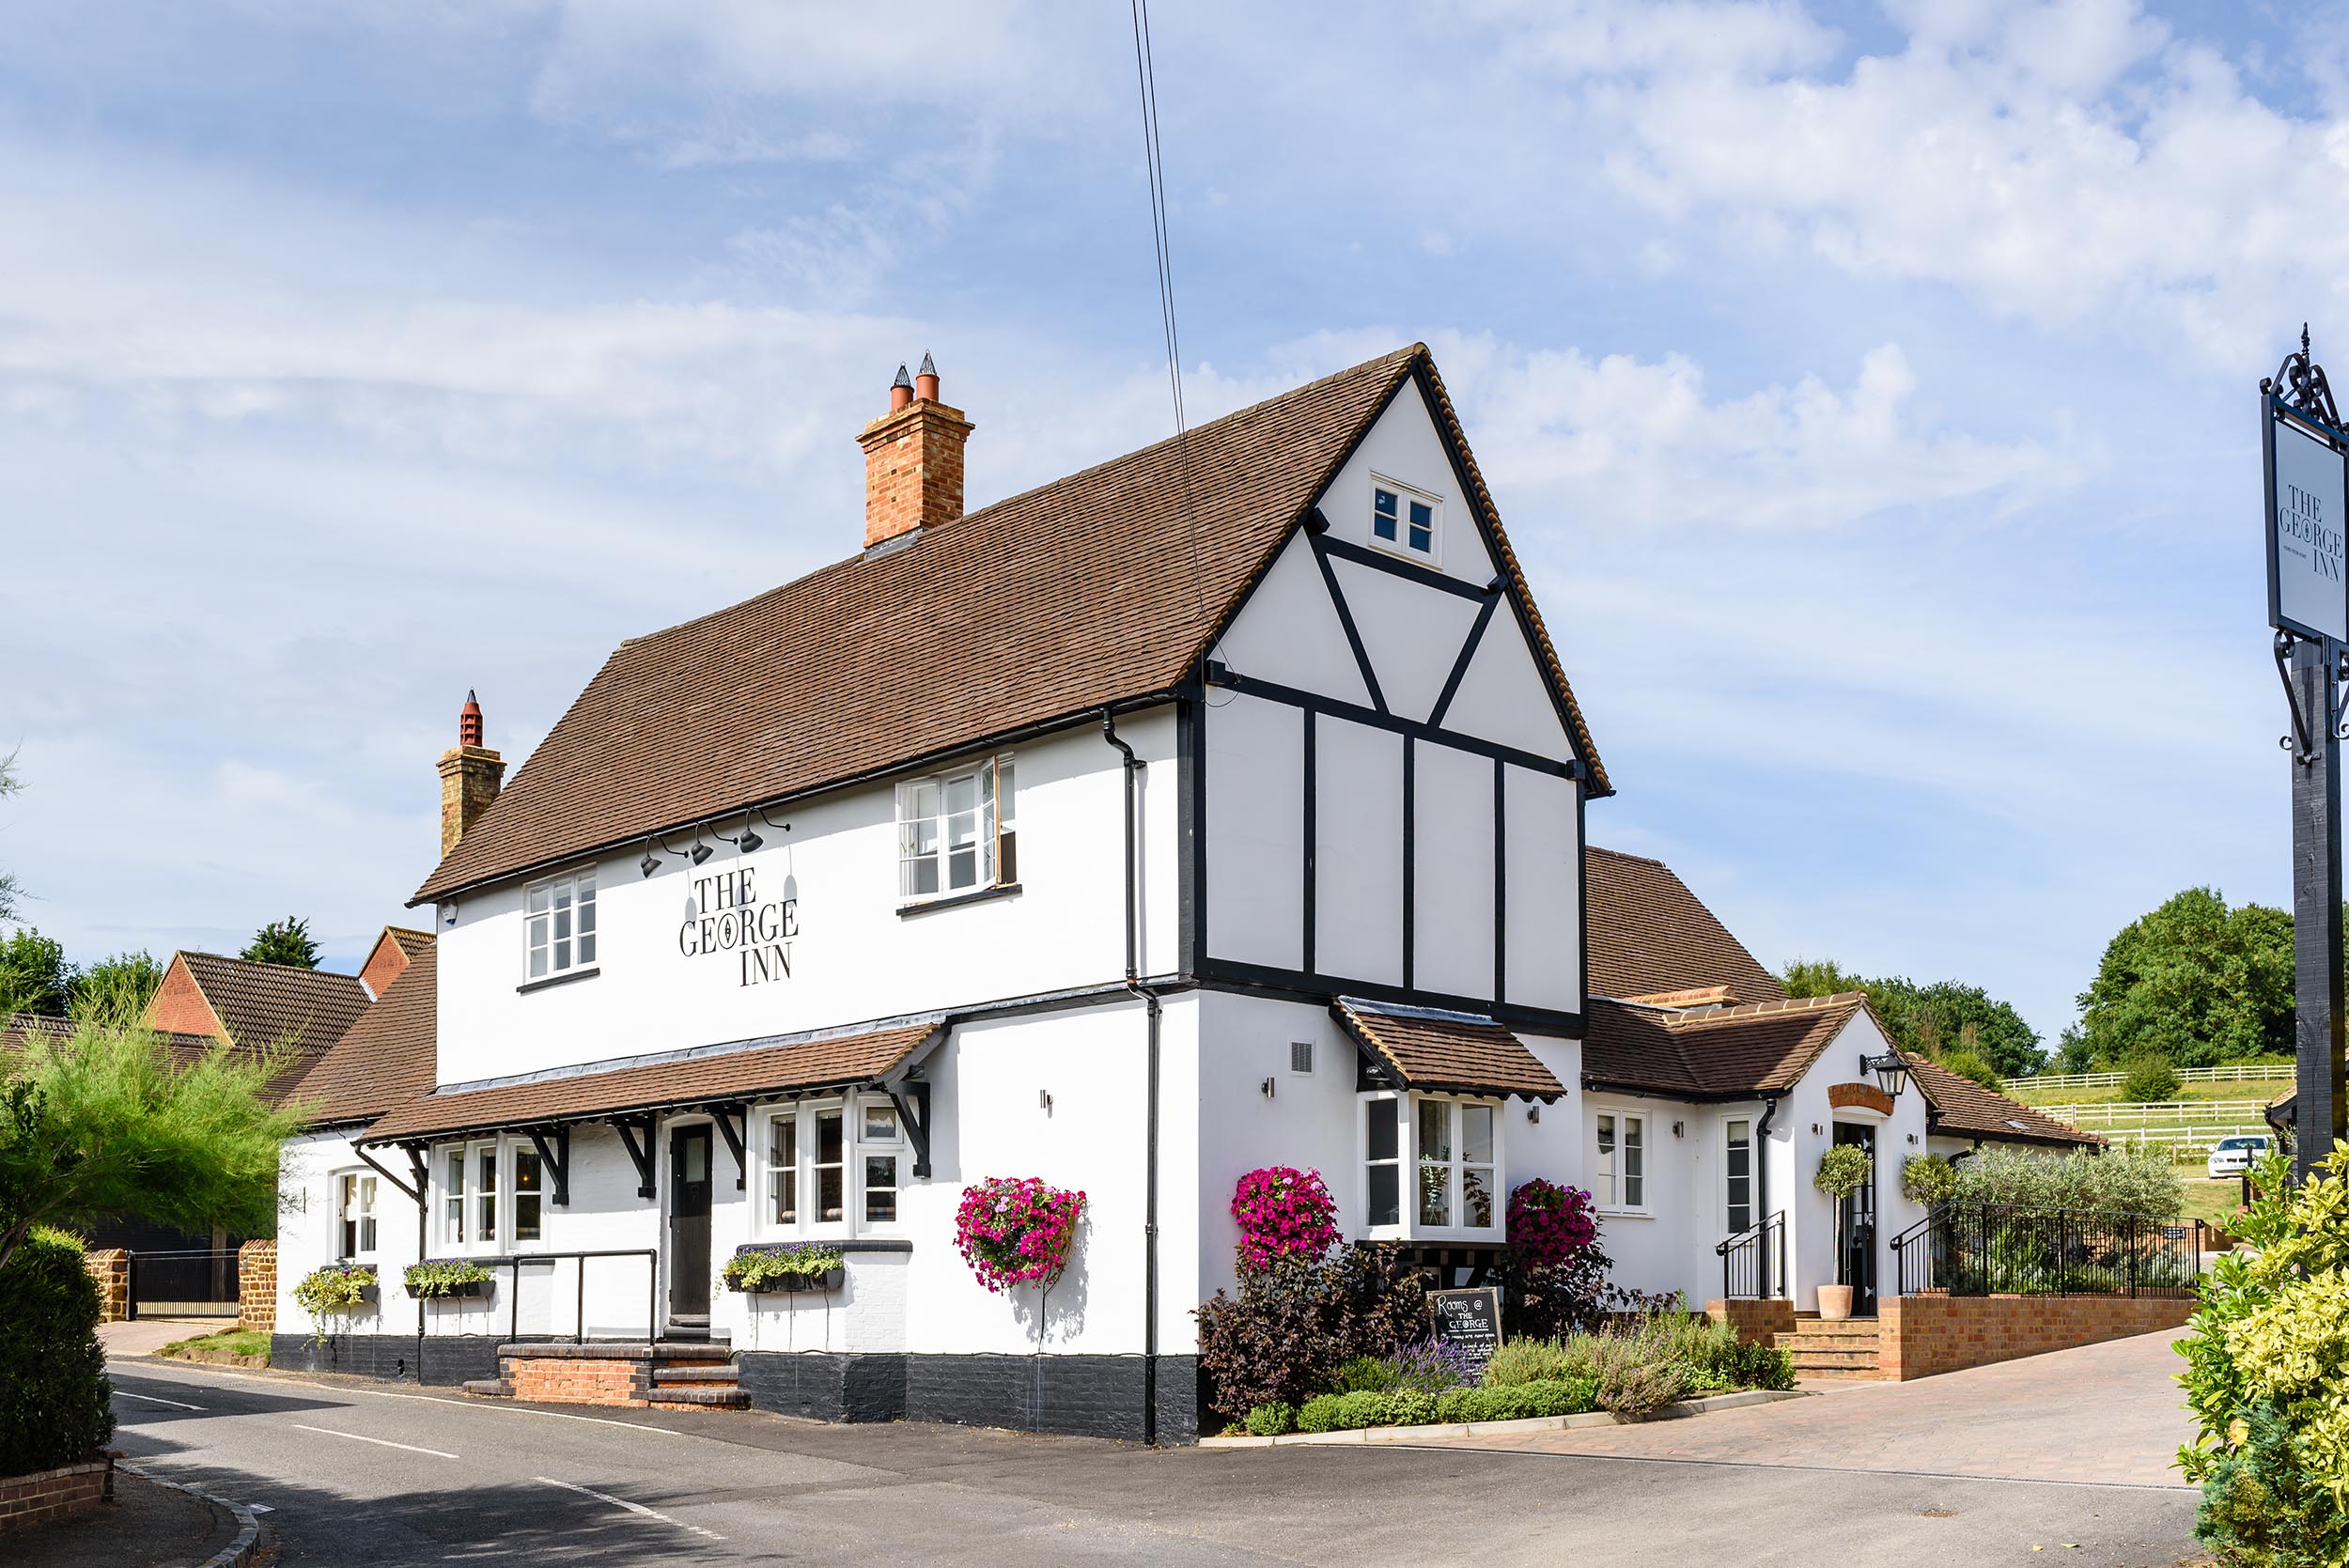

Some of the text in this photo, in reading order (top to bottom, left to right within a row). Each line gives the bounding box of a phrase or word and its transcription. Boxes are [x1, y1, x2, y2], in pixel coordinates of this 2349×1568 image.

[2289, 484, 2322, 522] THE
[2279, 506, 2342, 559] GEORGE
[2312, 547, 2340, 582] INN
[694, 867, 756, 914] THE
[679, 898, 799, 957] GEORGE
[739, 941, 793, 987] INN
[1436, 1295, 1469, 1317] Rooms
[1449, 1318, 1489, 1329] GEORGE
